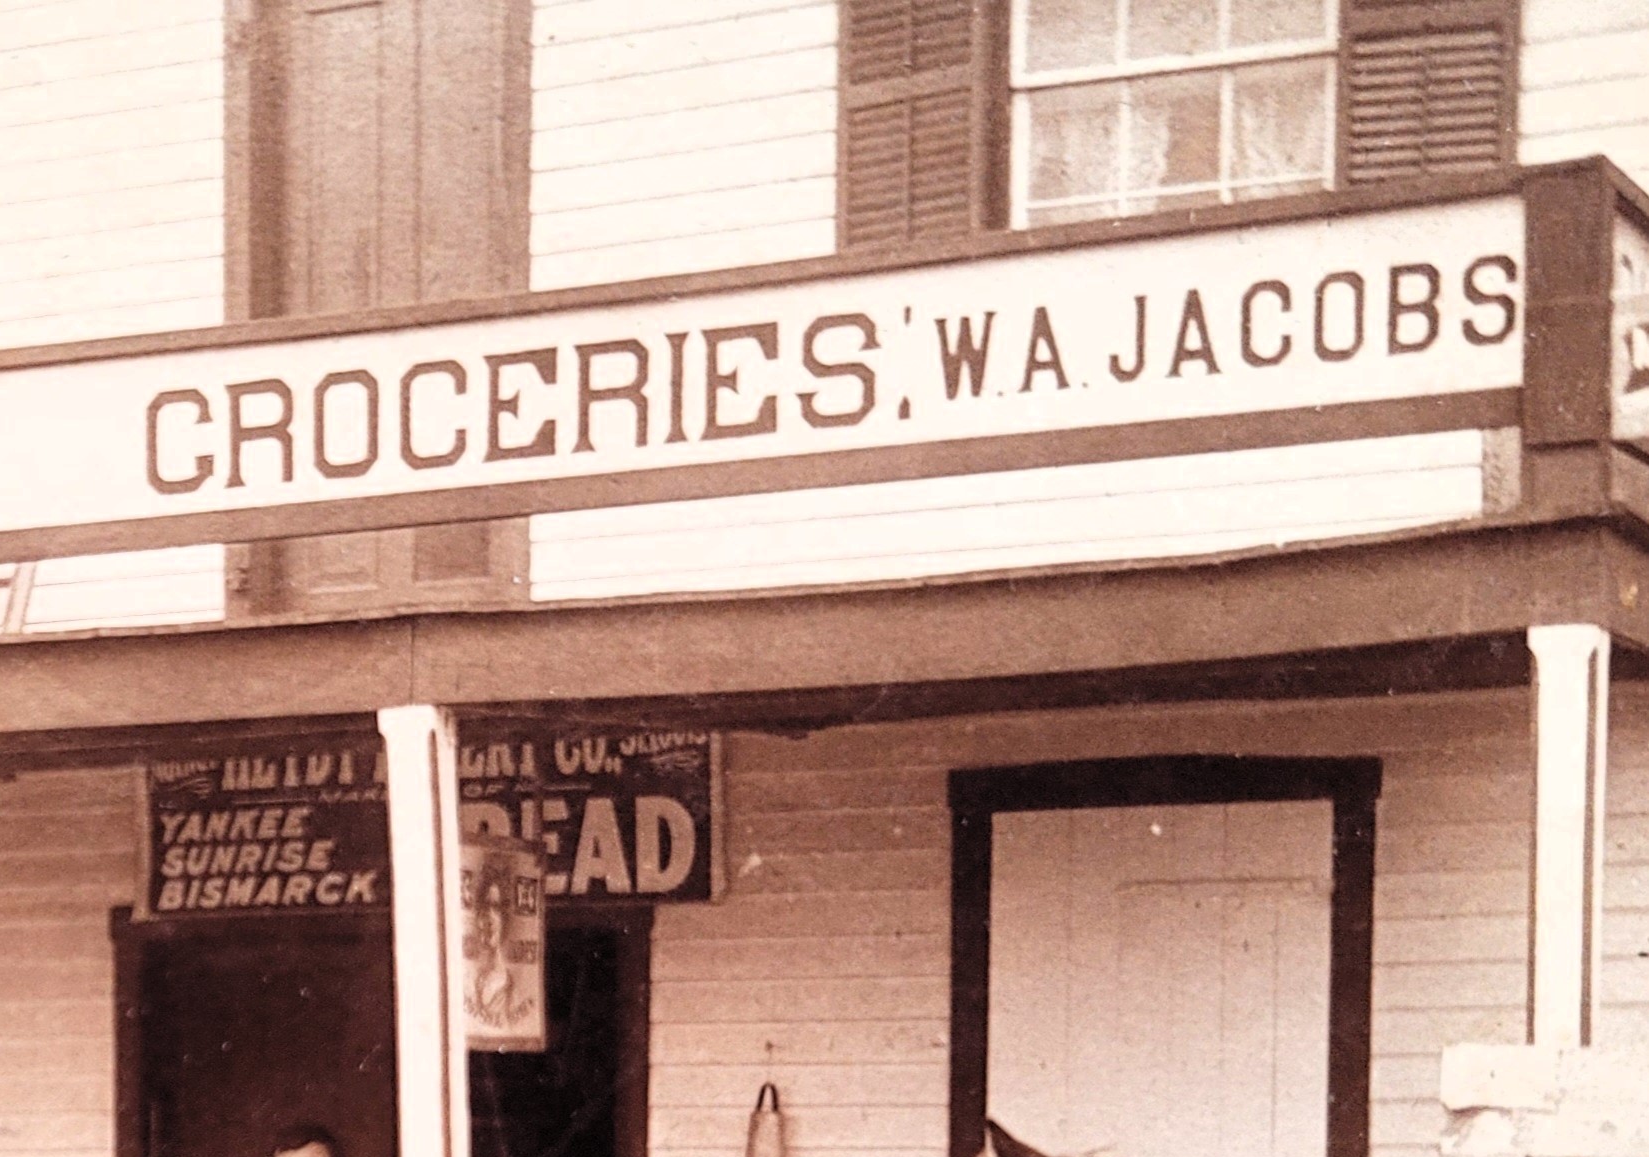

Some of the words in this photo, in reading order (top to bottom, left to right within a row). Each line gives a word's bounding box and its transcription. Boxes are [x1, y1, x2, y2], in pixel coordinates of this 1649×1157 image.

[1108, 255, 1520, 384] JACOBS
[159, 805, 312, 844] YANKEE
[160, 841, 336, 878] SUNRISE
[157, 870, 379, 911] BISMARCK
